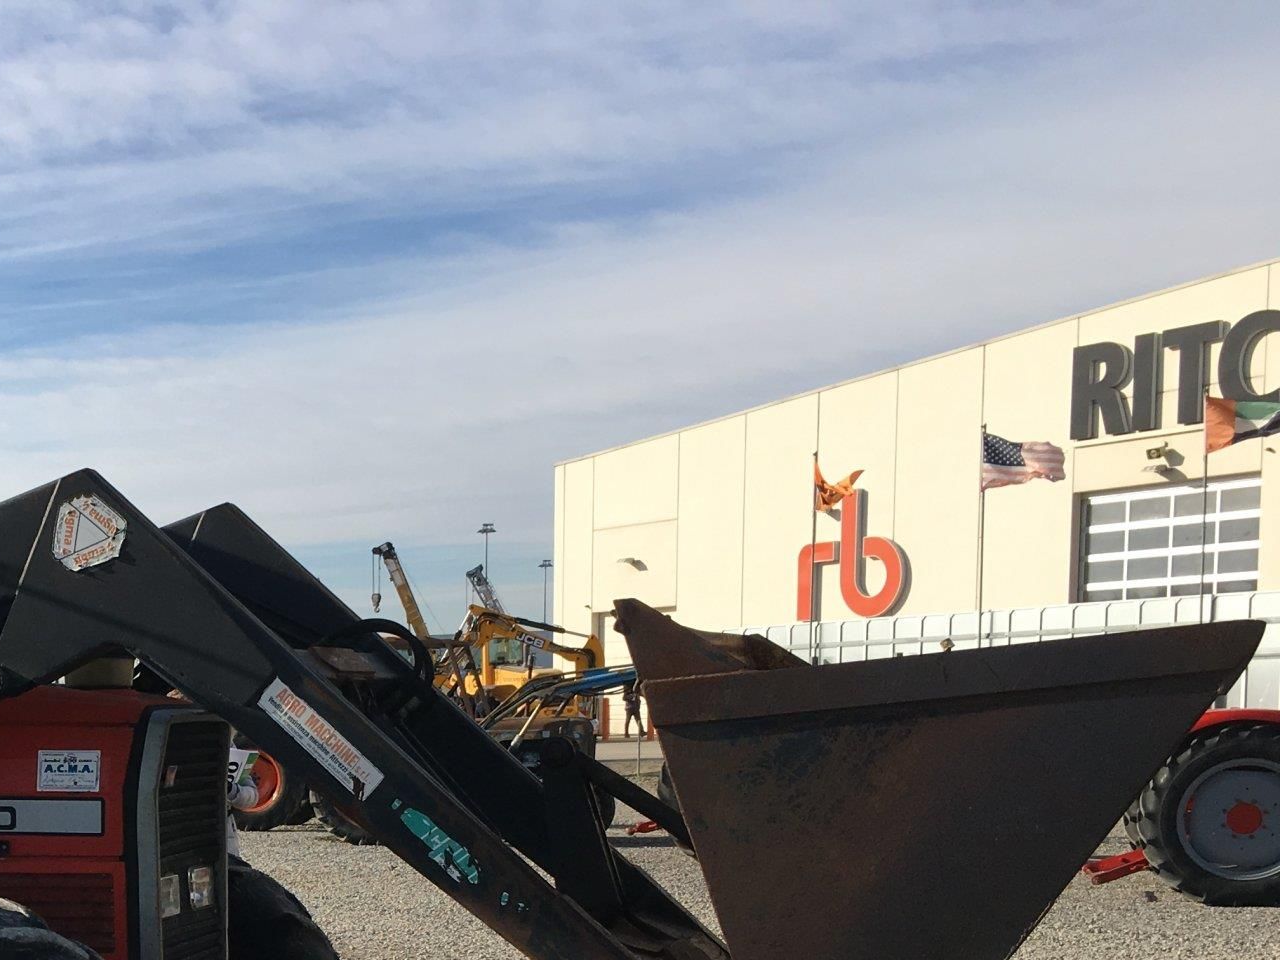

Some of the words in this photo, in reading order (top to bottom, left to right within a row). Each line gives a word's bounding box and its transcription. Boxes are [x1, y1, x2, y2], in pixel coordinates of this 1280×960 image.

[1070, 309, 1280, 440] RITC
[797, 489, 910, 622] rb
[516, 633, 545, 648] JCB
[276, 688, 307, 718] AGRO
[304, 714, 359, 768] MACCHINE
[44, 764, 94, 774] A.C.M.A.
